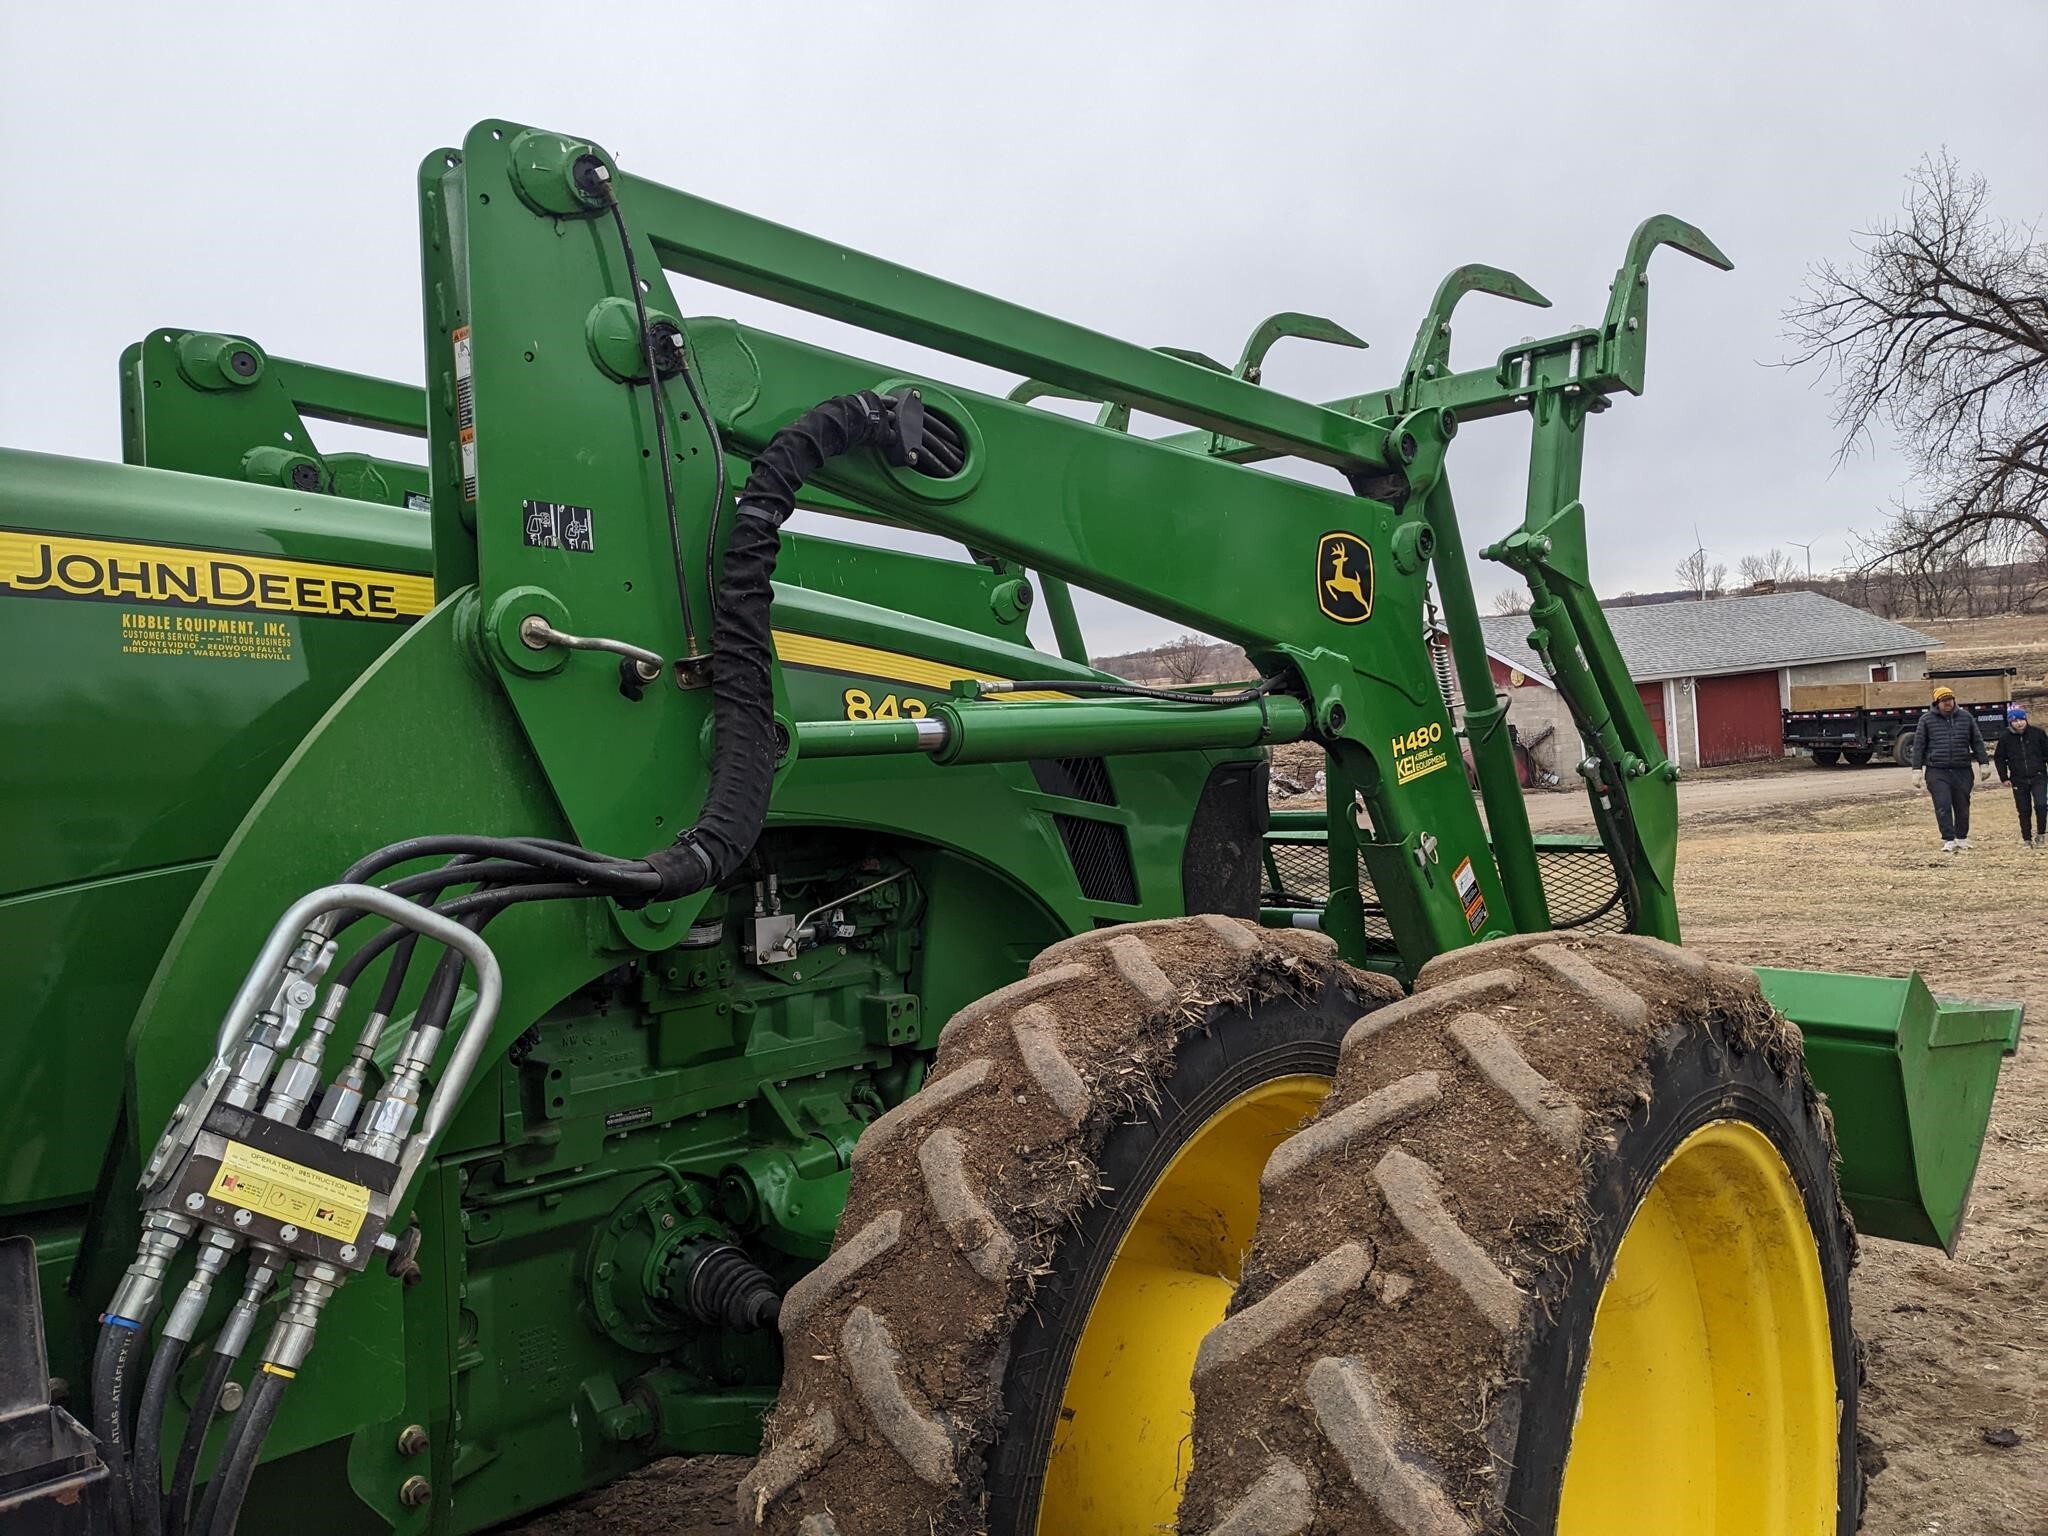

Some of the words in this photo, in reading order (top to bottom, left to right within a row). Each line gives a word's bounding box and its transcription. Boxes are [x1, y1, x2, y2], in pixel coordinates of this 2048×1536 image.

[15, 544, 198, 598] JOHN
[210, 561, 397, 614] DEERE
[122, 613, 171, 630] KIBBLE
[176, 616, 259, 636] EQUIPMENT,
[264, 622, 291, 637] INC.
[122, 629, 165, 641] CUSTOMER
[238, 636, 254, 645] OUR
[255, 637, 291, 648] BUSINESS
[122, 645, 146, 654] BIRD
[148, 647, 184, 656] ISLAND
[193, 649, 241, 658] WABASSO
[250, 652, 292, 661] RENVILLE
[132, 640, 197, 649] MONTEVIDEO
[207, 643, 255, 652] REDWOOD
[257, 646, 283, 654] FALLS
[1391, 722, 1442, 759] H480
[1416, 752, 1446, 771] EQUIPMENT
[250, 1152, 295, 1173] OPERATION
[298, 1169, 348, 1191] INSTRUCTION
[112, 1348, 129, 1402] ATLAFLEX
[111, 1410, 120, 1444] ATLAS
